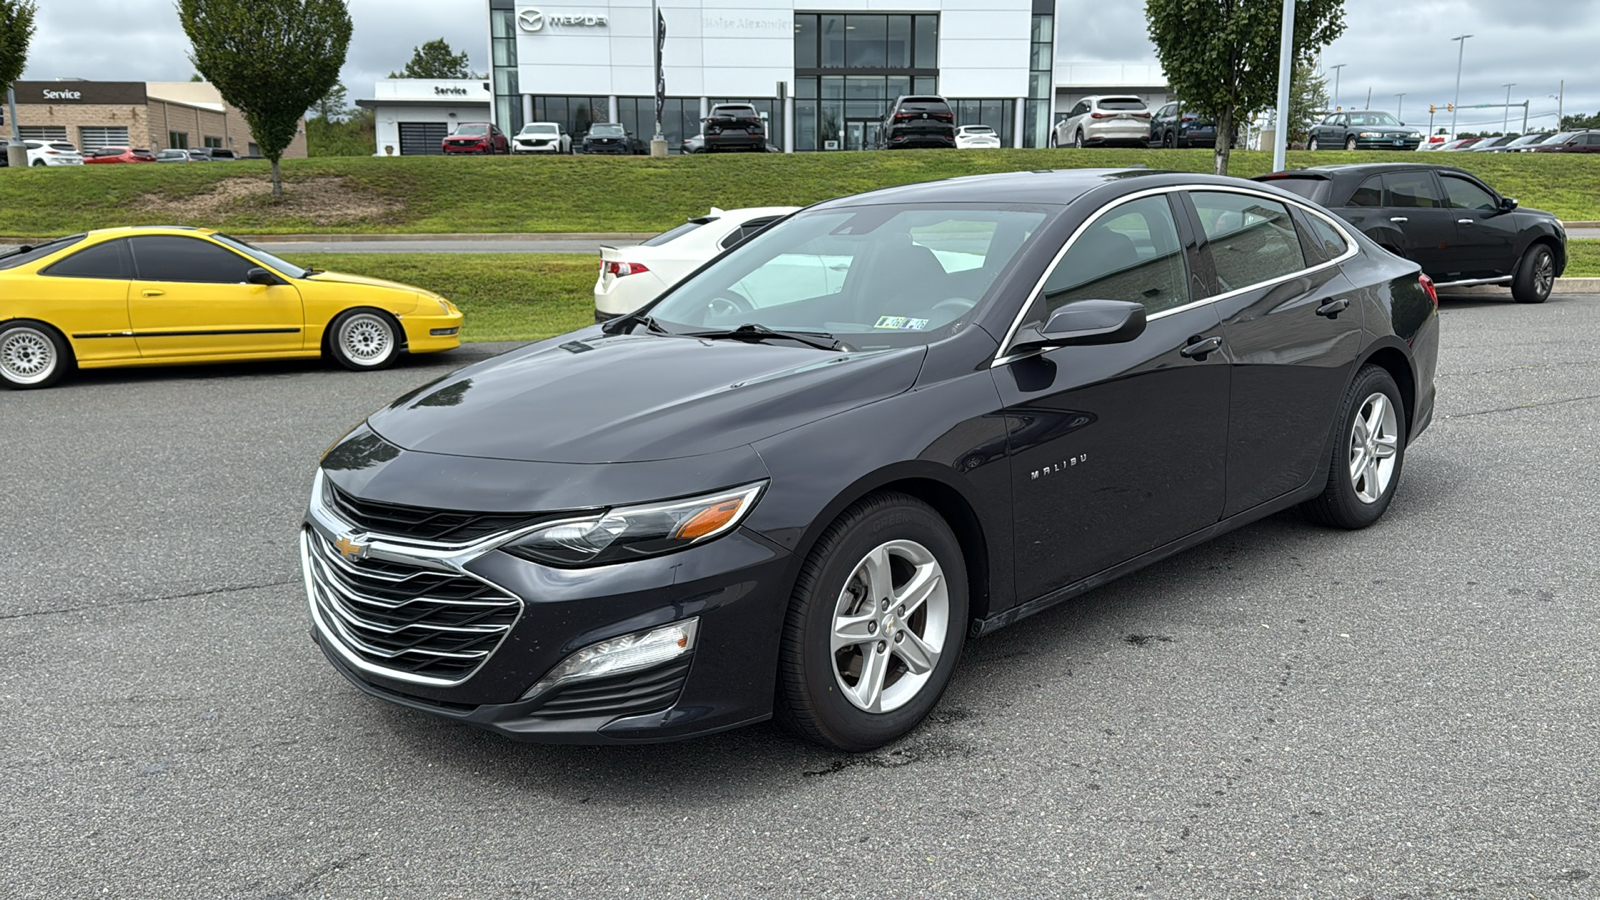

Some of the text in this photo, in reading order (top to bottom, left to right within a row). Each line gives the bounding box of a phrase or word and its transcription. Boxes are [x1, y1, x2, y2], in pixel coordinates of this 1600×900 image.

[43, 89, 81, 99] Service
[434, 86, 467, 95] Service
[1031, 453, 1087, 480] MALIBU
